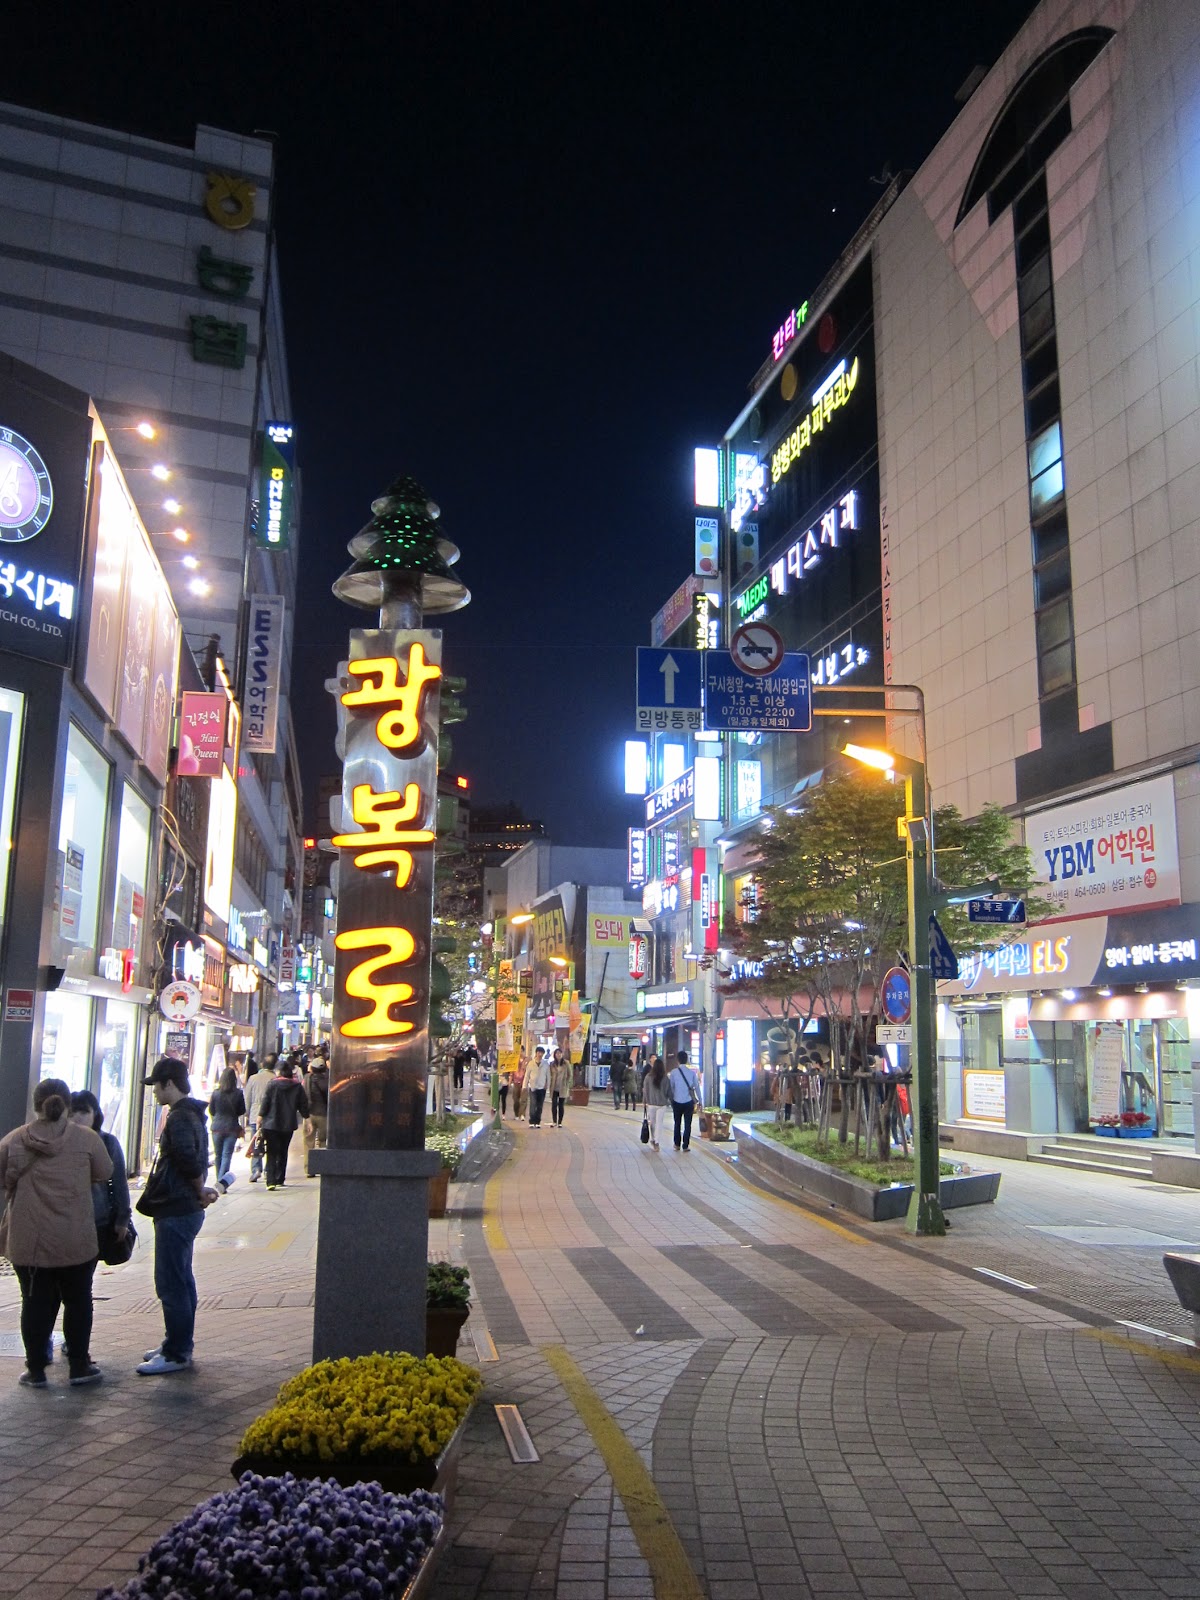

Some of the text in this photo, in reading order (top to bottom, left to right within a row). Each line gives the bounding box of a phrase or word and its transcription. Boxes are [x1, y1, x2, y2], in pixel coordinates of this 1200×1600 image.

[770, 372, 850, 484] 성형외과 피부과
[696, 519, 718, 529] 나이스
[741, 575, 768, 618] MEDIS
[42, 623, 63, 638] LTD.
[254, 609, 271, 684] ESS
[730, 695, 746, 706] 1.5
[764, 696, 786, 707] 이상
[185, 709, 221, 727] 김정일
[248, 686, 268, 739] 어학원
[638, 709, 700, 730] 일방통행
[721, 706, 752, 716] 07:00
[765, 707, 796, 717] 22:00
[200, 732, 220, 743] Hair
[192, 746, 219, 761] Queen
[332, 642, 442, 1038] 광복로
[1044, 824, 1155, 882] YBM 어학원
[594, 918, 624, 941] 임대
[1032, 936, 1068, 975] ELS
[886, 991, 909, 1000] 주차금지
[882, 1029, 906, 1040] 구간
